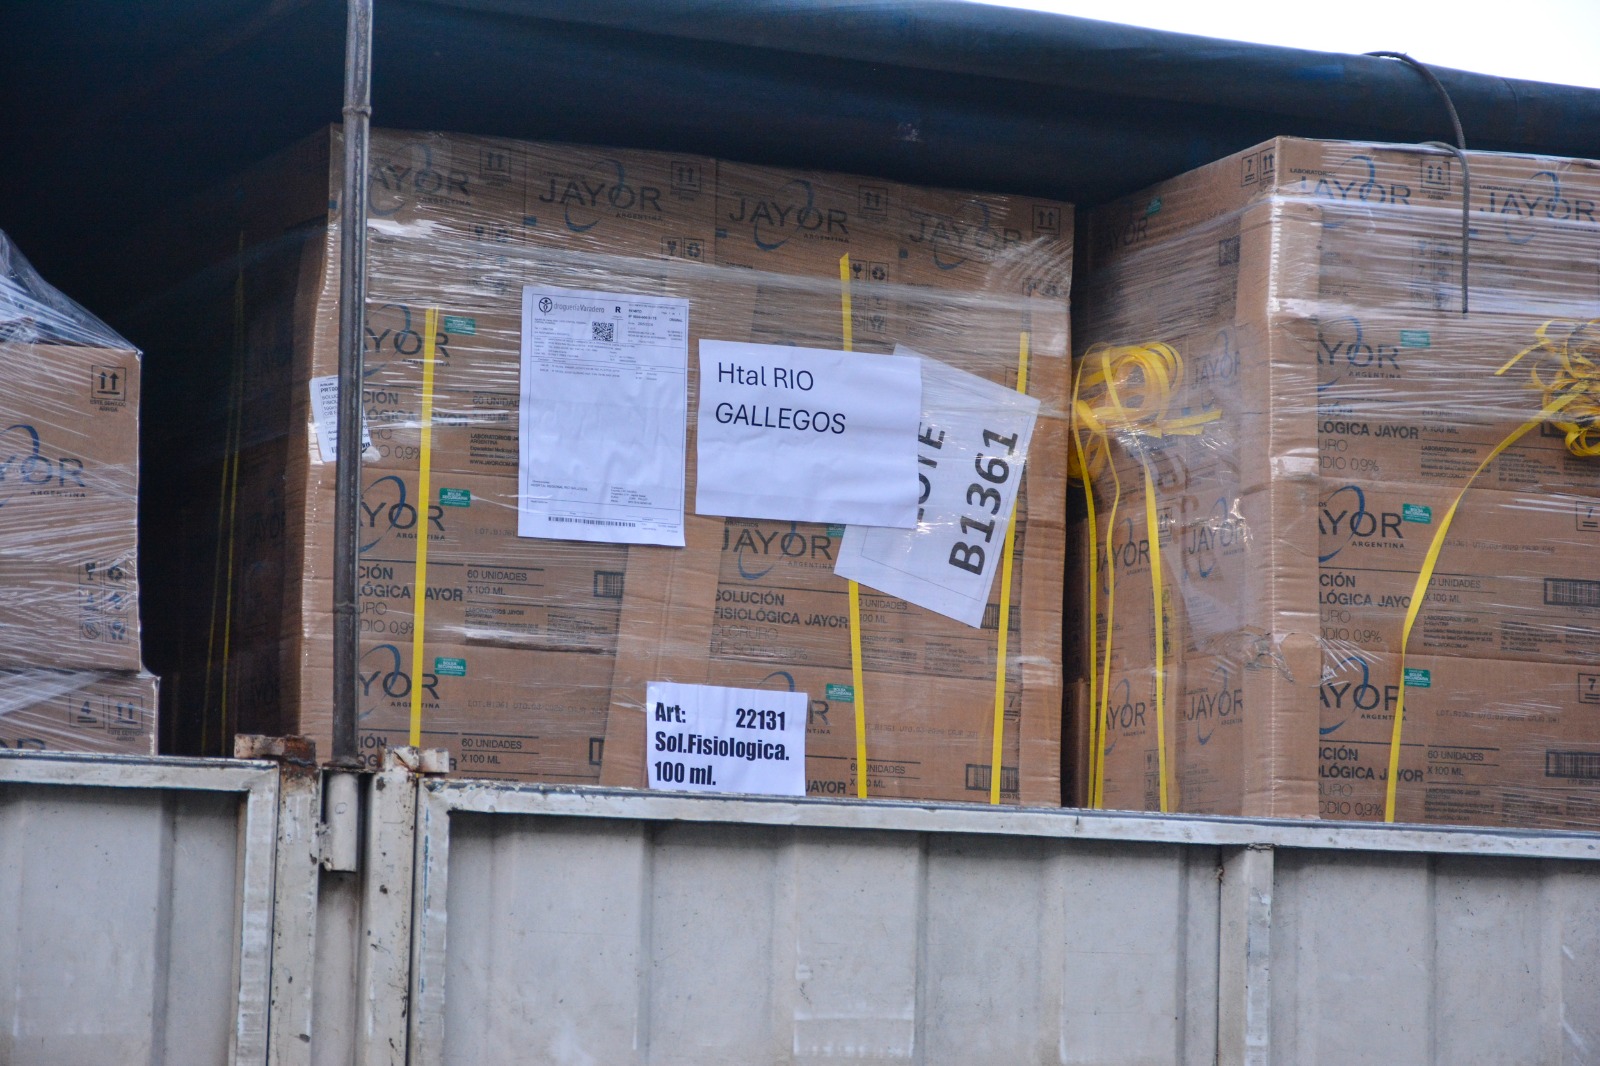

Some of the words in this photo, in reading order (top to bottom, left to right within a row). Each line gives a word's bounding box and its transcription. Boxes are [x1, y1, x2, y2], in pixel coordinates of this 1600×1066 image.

[368, 163, 470, 196] AYOR
[539, 178, 662, 211] JAYOR
[1480, 191, 1598, 222] JAYOR
[729, 197, 849, 234] JAYOR
[615, 306, 621, 314] R
[718, 362, 767, 387] Htal
[774, 368, 814, 391] RIO
[715, 402, 847, 435] GALLEGOS
[1375, 424, 1419, 440] JAYOR
[1350, 458, 1380, 473] 0,9%
[949, 428, 1018, 576] B1361
[721, 526, 833, 561] JAYOR
[1352, 541, 1406, 550] ARGENTINA
[787, 560, 834, 570] ARGENTINA
[467, 569, 479, 579] 60
[481, 571, 528, 582] UNIDADES
[467, 585, 473, 594] X
[474, 586, 490, 595] 100
[492, 588, 506, 596] ML
[1438, 578, 1482, 589] UNIDADES
[714, 589, 785, 607] SOLUCIÓN
[864, 599, 908, 611] UNIDADES
[1433, 593, 1448, 603] 100
[1448, 595, 1462, 604] ML
[713, 607, 801, 625] FISIOLÓGICA
[804, 614, 849, 630] JAYOR
[874, 614, 889, 625] ML
[1353, 627, 1383, 644] 0,9%
[654, 702, 687, 725] Art:
[735, 708, 786, 732] 22131
[461, 738, 474, 749] 60
[475, 739, 522, 750] UNIDADES
[654, 731, 791, 762] Sol.Fisiologica.
[461, 754, 468, 763] X
[469, 755, 486, 764] 100
[487, 755, 501, 765] ML
[1427, 750, 1441, 760] 60
[1441, 751, 1484, 762] UNIDADES
[654, 761, 686, 785] 100
[688, 764, 717, 787] ml.
[1433, 768, 1450, 776] 100
[1451, 769, 1464, 777] ML
[806, 779, 847, 795] JAYOR
[873, 780, 886, 789] ML
[1354, 802, 1384, 816] 0,9%
